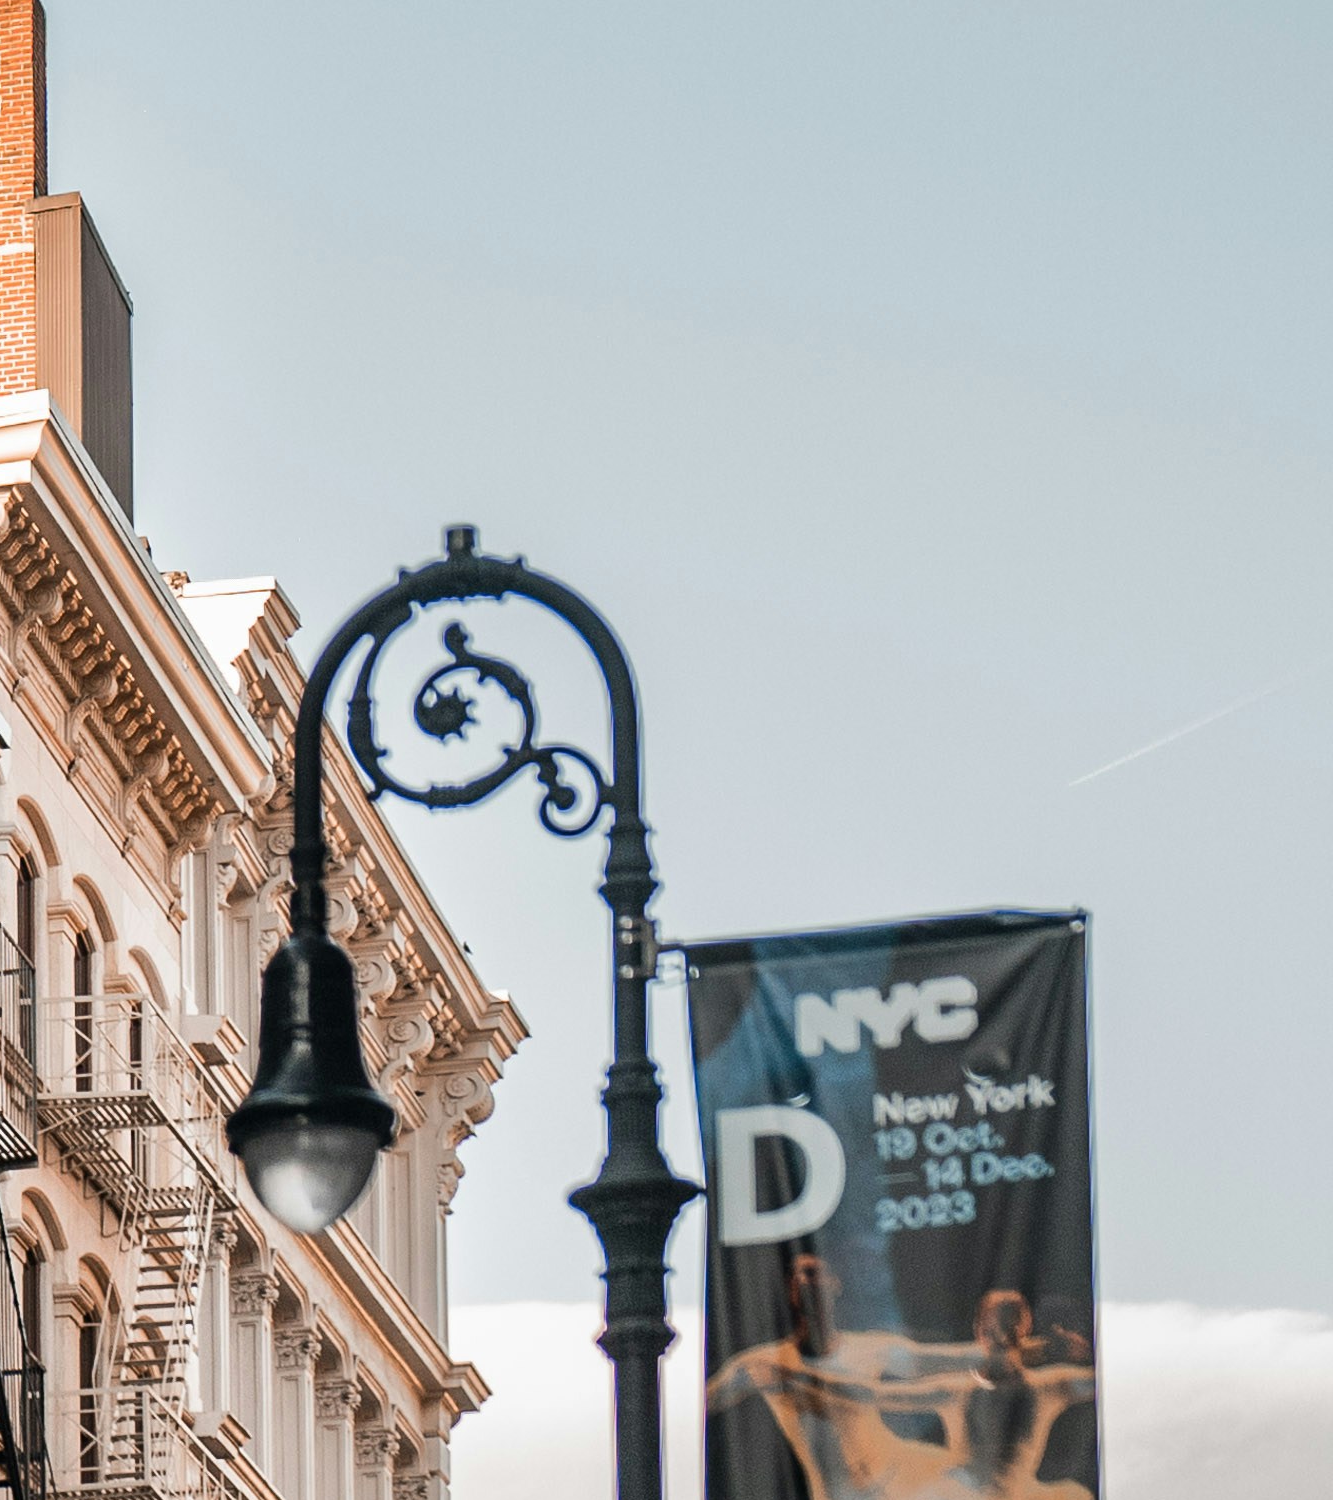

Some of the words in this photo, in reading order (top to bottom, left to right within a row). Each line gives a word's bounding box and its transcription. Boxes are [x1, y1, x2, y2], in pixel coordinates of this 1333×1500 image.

[794, 976, 978, 1058] NYC
[873, 1091, 959, 1126] New
[964, 1074, 1056, 1115] York
[873, 1126, 918, 1161] 19
[922, 1120, 1006, 1156] Oct.
[715, 1104, 846, 1247] D
[922, 1155, 964, 1190] 14
[971, 1150, 1055, 1186] Dec.
[874, 1190, 978, 1233] 2023
